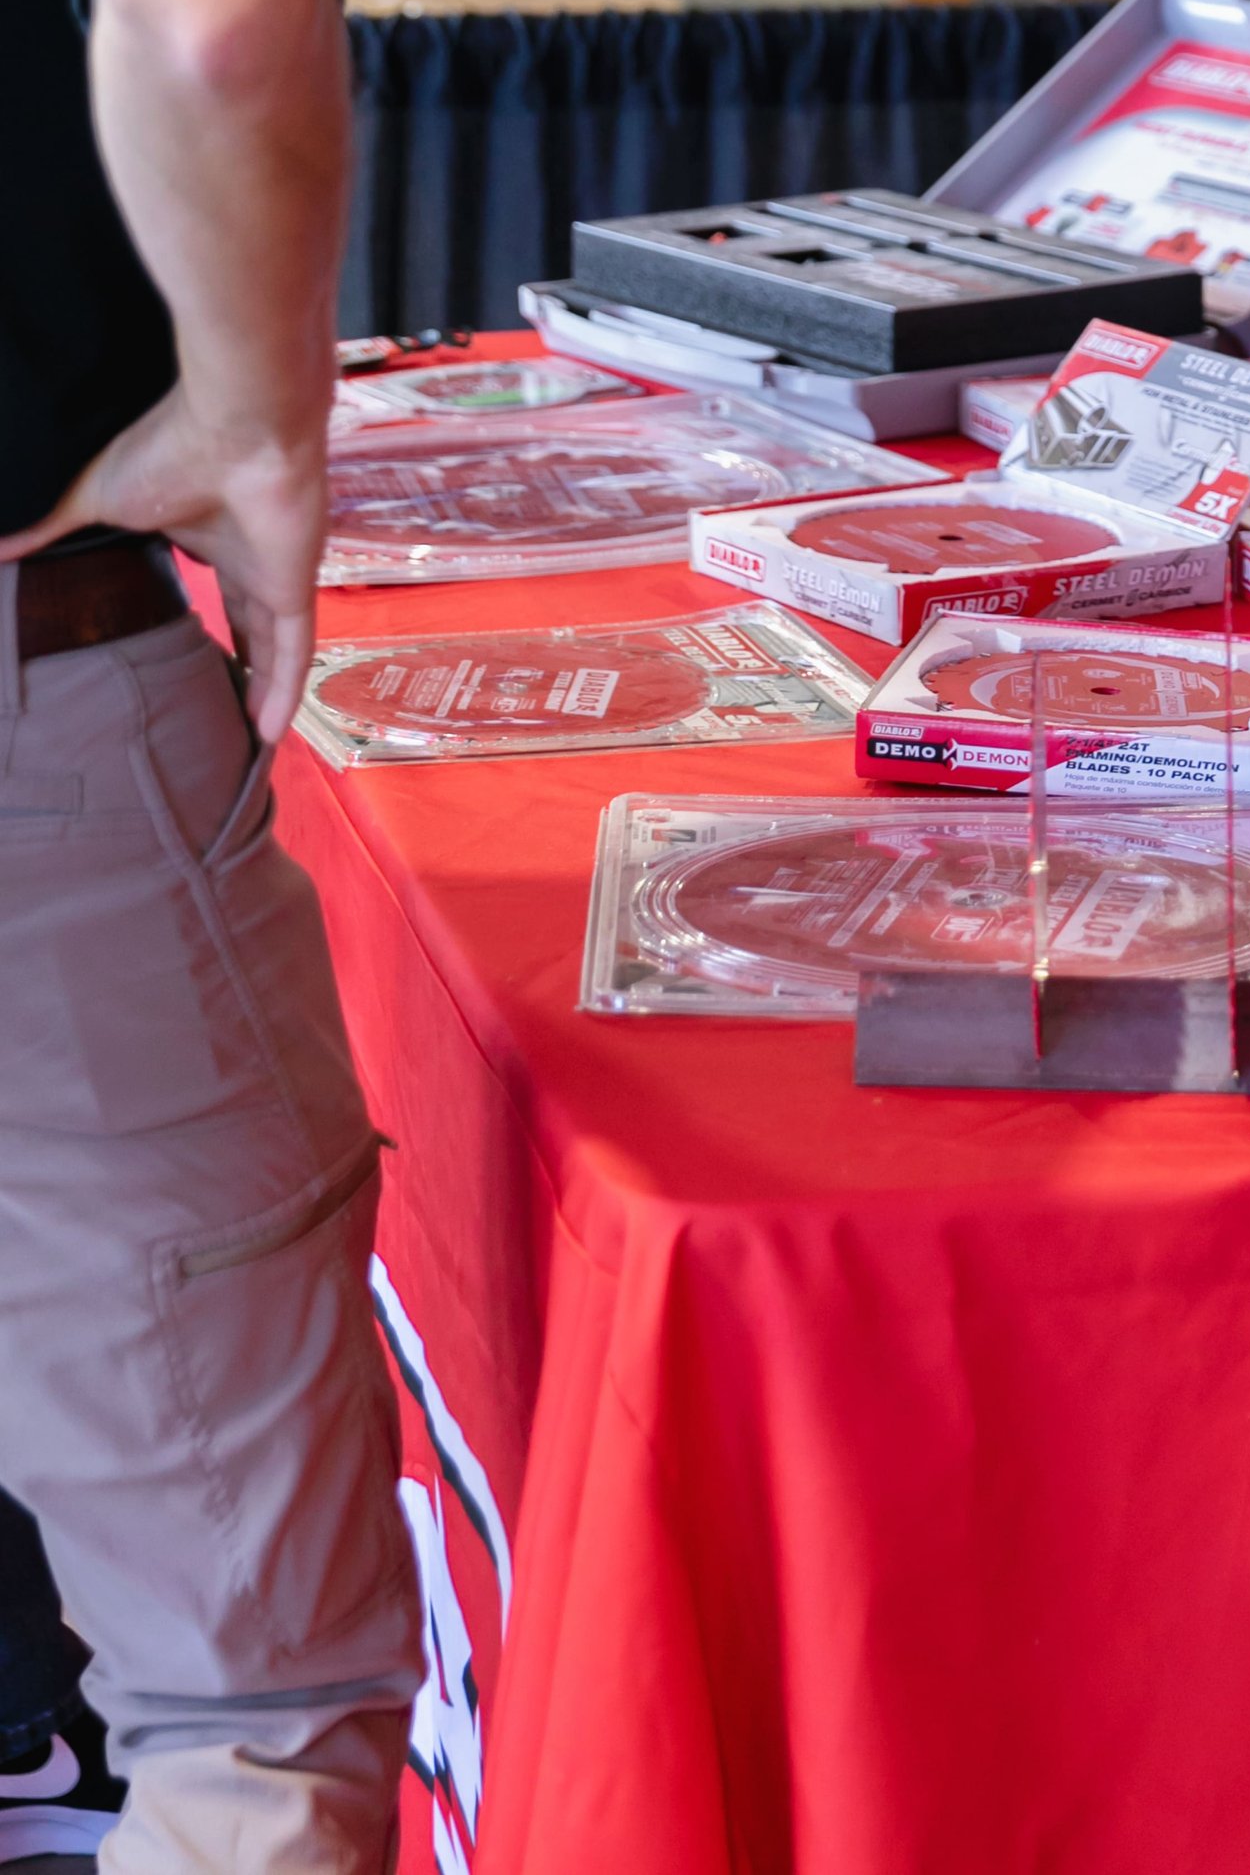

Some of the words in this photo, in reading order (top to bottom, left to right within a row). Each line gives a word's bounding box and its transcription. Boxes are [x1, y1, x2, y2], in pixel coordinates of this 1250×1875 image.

[1180, 353, 1230, 380] STEEL
[1194, 490, 1239, 520] 5X
[709, 542, 750, 571] DIABLO
[783, 562, 825, 593] STEEL
[828, 578, 881, 613] DEMON
[1053, 571, 1118, 597] STEEL
[1128, 558, 1206, 588] DEMON
[929, 594, 998, 617] DIABLO
[1071, 591, 1125, 611] CERMET
[1138, 586, 1192, 602] CARBIDE
[576, 671, 611, 705] DIABLO
[873, 725, 910, 737] DIABLO
[874, 741, 937, 760] DEMO
[962, 749, 1031, 767] DEMON
[1117, 741, 1150, 753] 24T
[1065, 748, 1240, 773] FRAMING/DEMOLITION
[1065, 761, 1131, 775] BLADES
[1148, 768, 1167, 778] 10
[1170, 770, 1217, 783] PACK
[1064, 772, 1086, 782] Hoja
[1087, 773, 1099, 782] de
[1100, 775, 1135, 786] máxima
[1136, 778, 1195, 791] construcción
[1064, 781, 1102, 793] Paquete
[1116, 786, 1127, 794] 10
